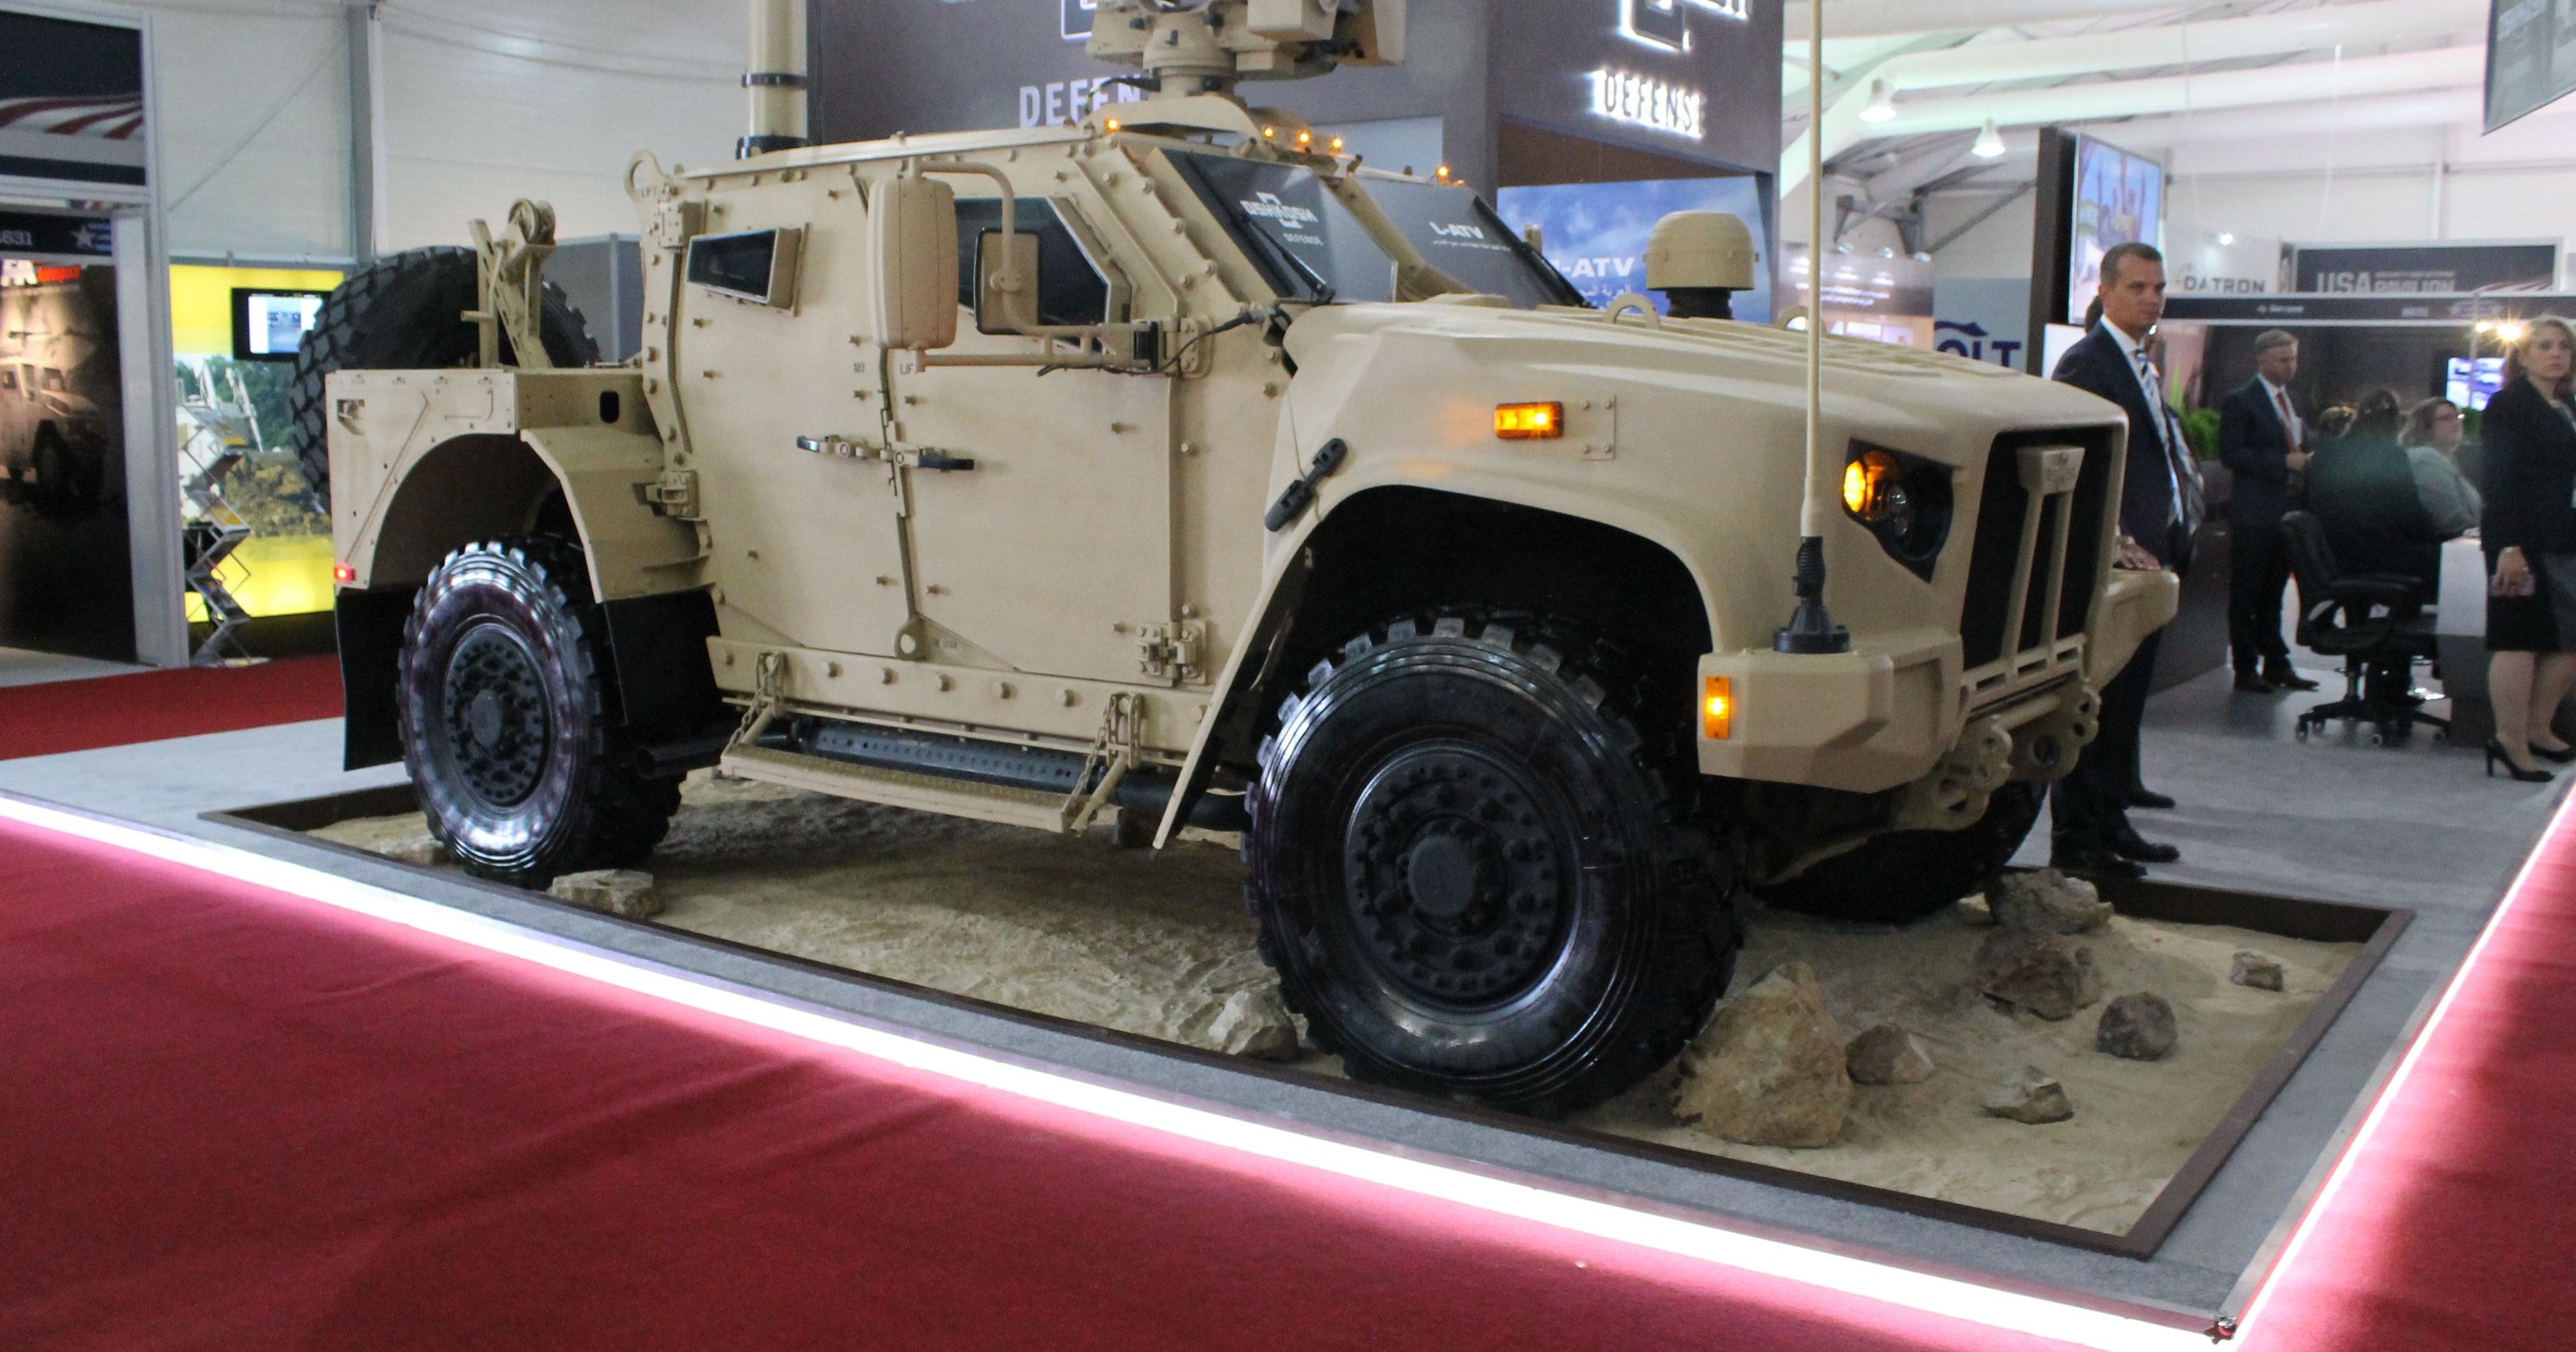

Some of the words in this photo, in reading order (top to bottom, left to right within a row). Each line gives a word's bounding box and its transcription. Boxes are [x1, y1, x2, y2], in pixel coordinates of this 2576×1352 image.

[1018, 73, 1141, 129] DEFEN
[1596, 69, 1707, 138] DEFENSE
[1429, 221, 1484, 239] L-ATV
[2183, 275, 2266, 294] DATRON
[2317, 271, 2372, 293] USA
[899, 362, 914, 376] LIF
